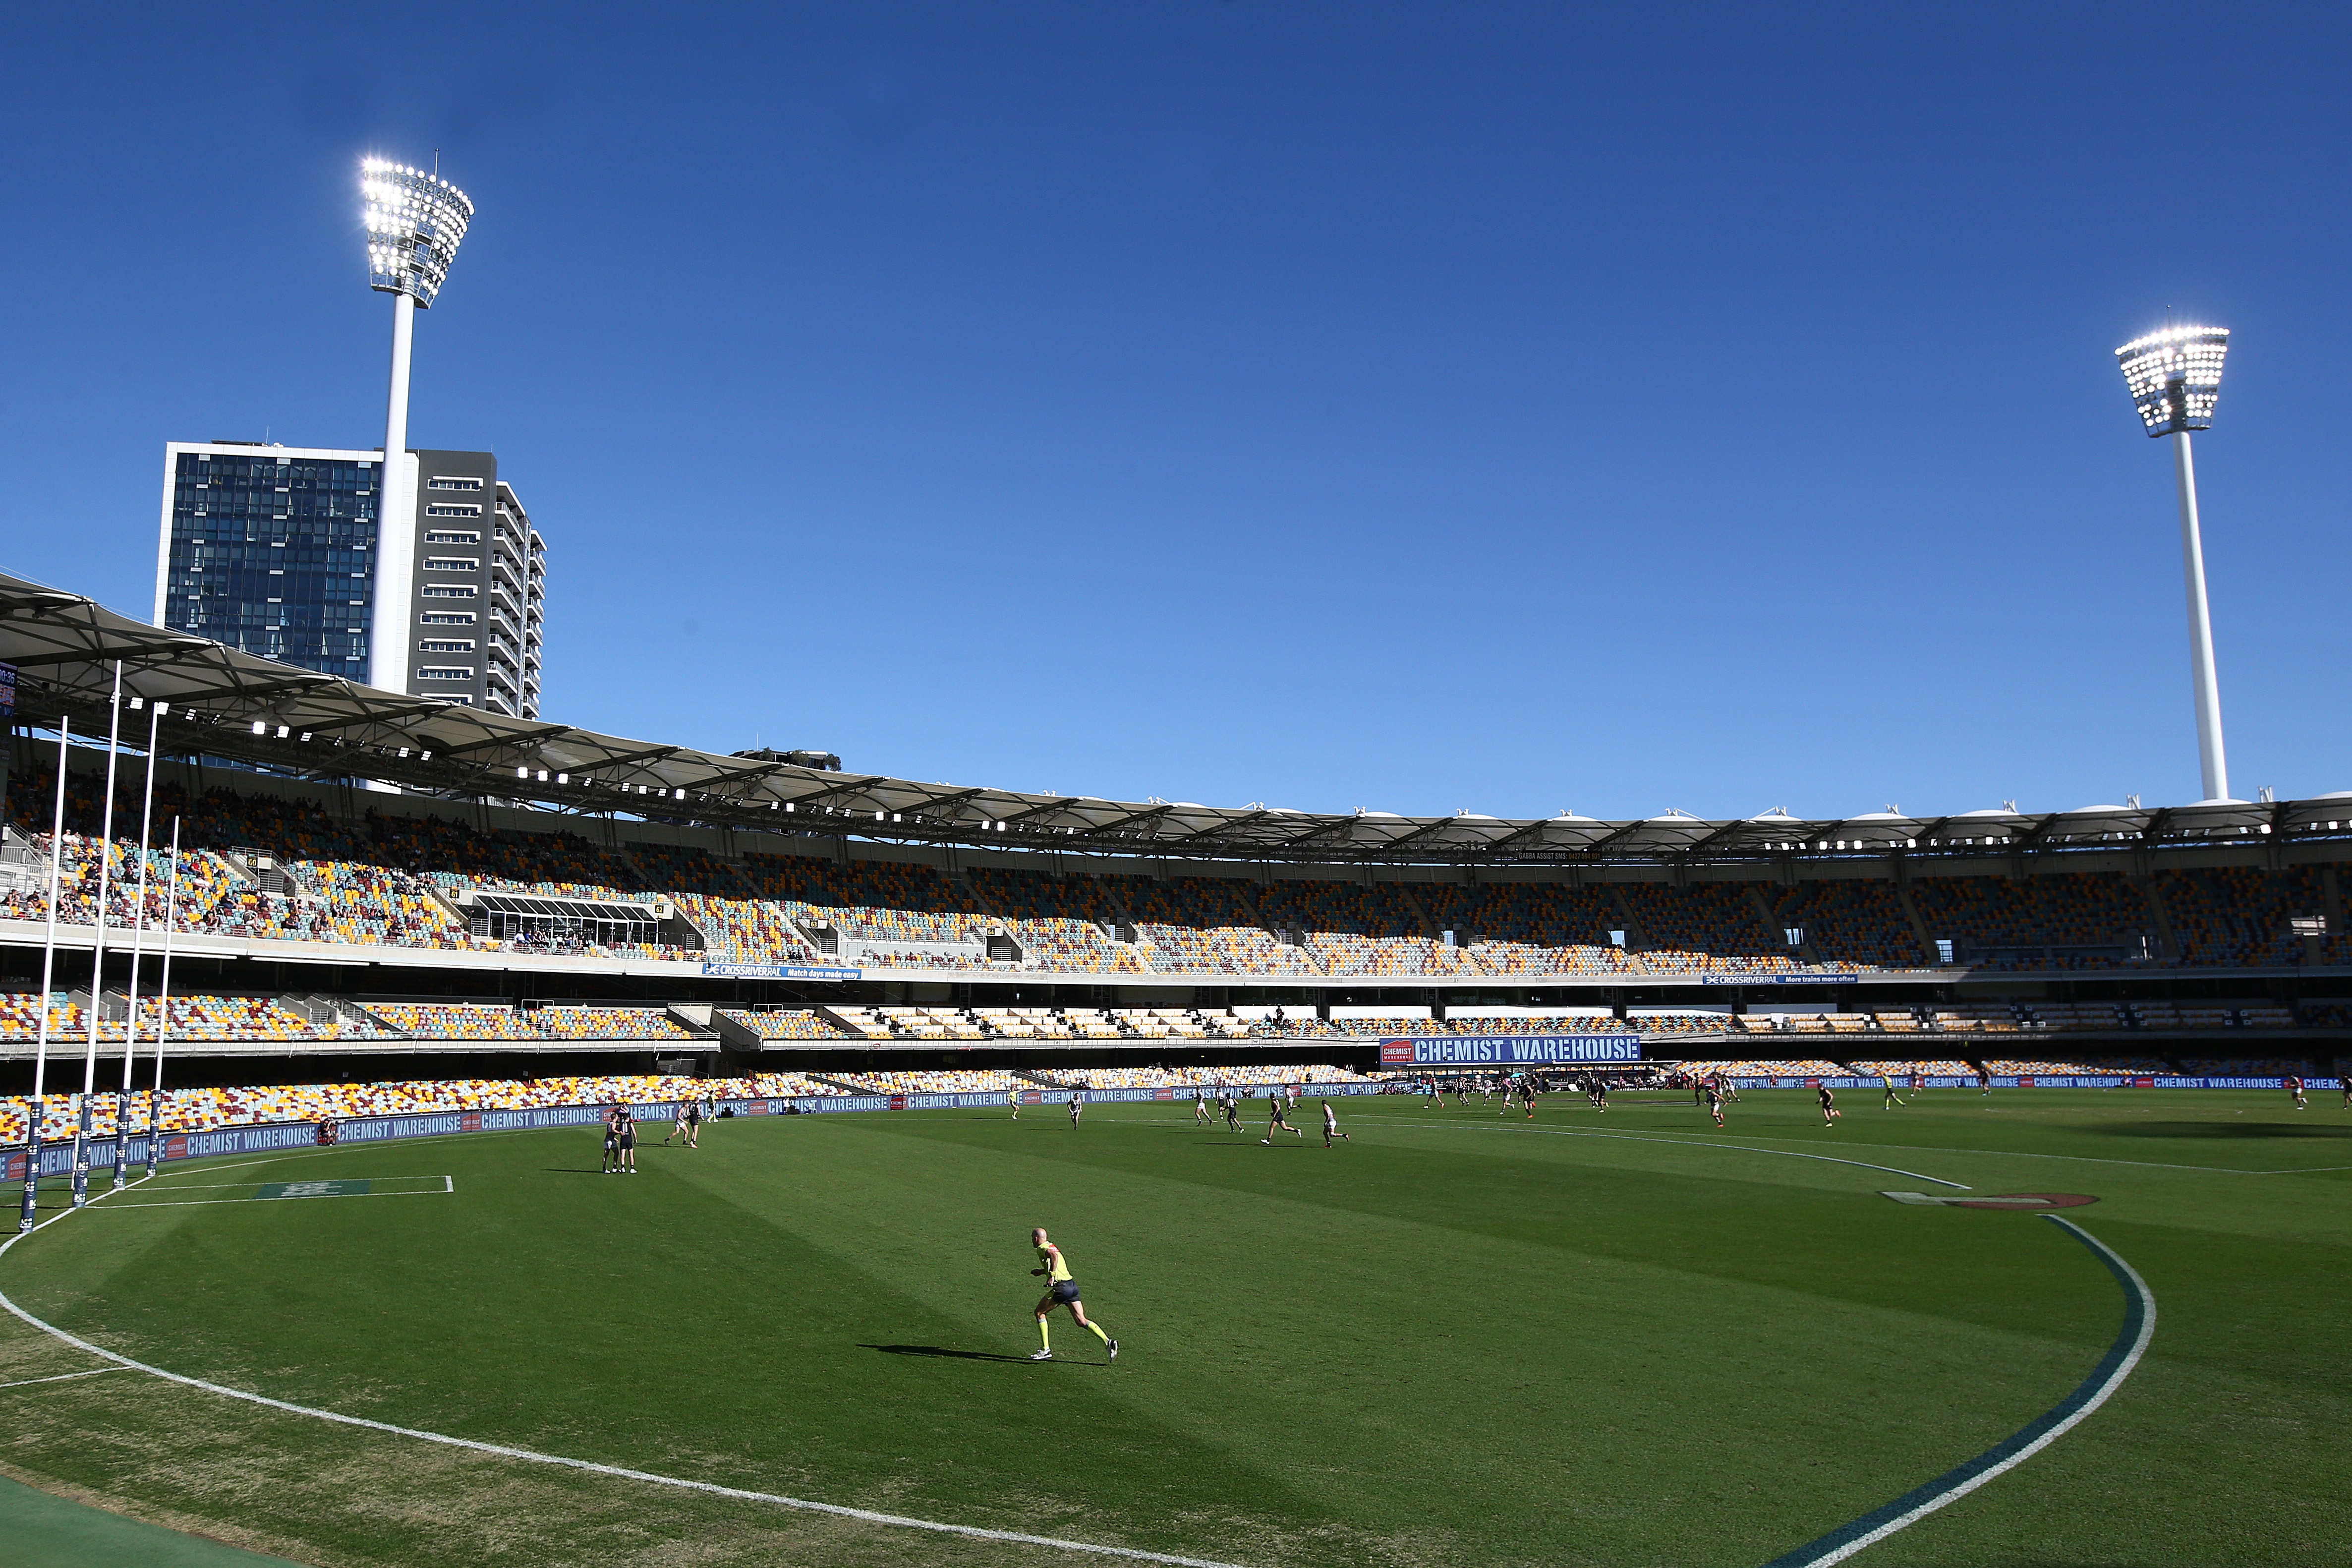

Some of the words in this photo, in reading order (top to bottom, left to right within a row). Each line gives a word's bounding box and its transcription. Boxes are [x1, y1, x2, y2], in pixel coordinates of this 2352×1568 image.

[0, 669, 15, 684] 0:36
[720, 966, 781, 977] CROSSRIVERRAIL
[808, 970, 824, 979] days
[843, 972, 859, 980] easy
[1415, 1039, 1504, 1062] CHEMIST
[1512, 1039, 1638, 1060] WAREHOUSE
[1924, 1077, 1962, 1087] CHEMIST
[1964, 1077, 2018, 1087] WAHOUSE
[2034, 1077, 2073, 1087] CHEMIST
[2154, 1077, 2204, 1088] CHEMIST
[2208, 1078, 2282, 1088] WAREHOUSE
[2304, 1079, 2340, 1089] CHEM
[908, 1095, 955, 1108] CHEMIST
[958, 1093, 1023, 1106] WAREHOUE
[1090, 1090, 1153, 1102] WAREHOUSE
[820, 1097, 887, 1111] WAREHOUSE
[482, 1112, 530, 1129] CHEMIST
[533, 1108, 599, 1126] WAREHOUSE
[630, 1105, 674, 1119] HEMIST
[338, 1121, 389, 1141] CHEMIST
[393, 1115, 460, 1136] WAREHOUSE
[187, 1133, 240, 1155] CHEMIST
[244, 1127, 314, 1149] WAREHOUSE
[41, 1149, 72, 1173] HEMI
